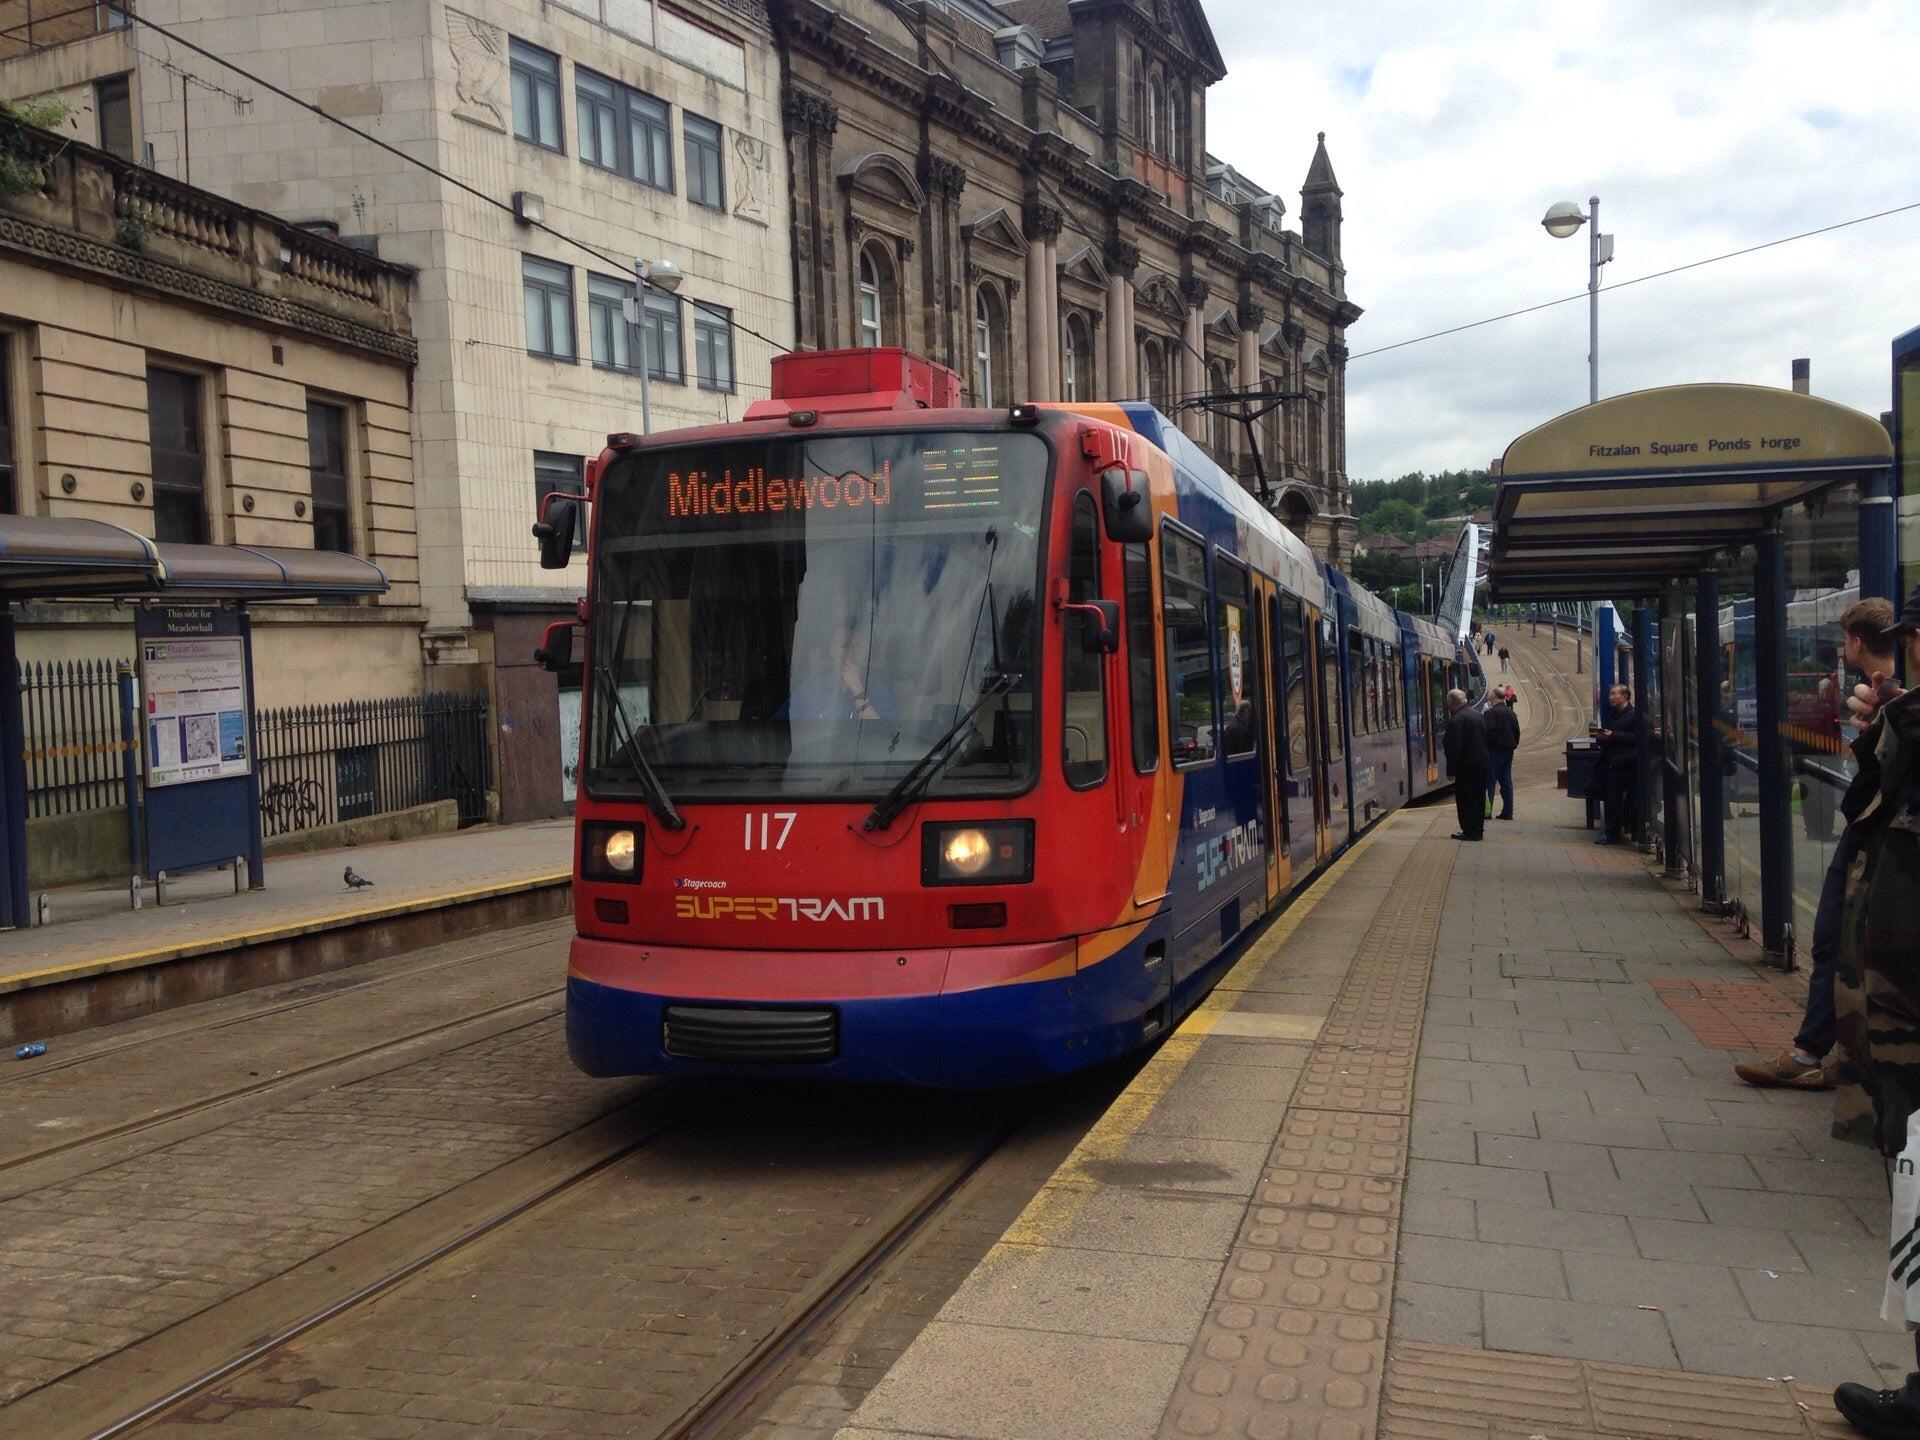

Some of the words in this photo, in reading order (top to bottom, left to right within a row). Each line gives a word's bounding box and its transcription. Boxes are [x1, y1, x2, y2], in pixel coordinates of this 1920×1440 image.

[1589, 444, 1640, 457] Fitzalan
[1650, 441, 1698, 456] Square
[1708, 438, 1751, 451] Ponds
[668, 458, 891, 516] Middlewood
[167, 608, 184, 618] This
[185, 608, 199, 618] side
[200, 608, 211, 618] for
[167, 623, 213, 632] Meadowhall
[744, 812, 797, 850] 117
[683, 878, 727, 889] Stagecoach
[675, 895, 885, 921] SUPERTRAM
